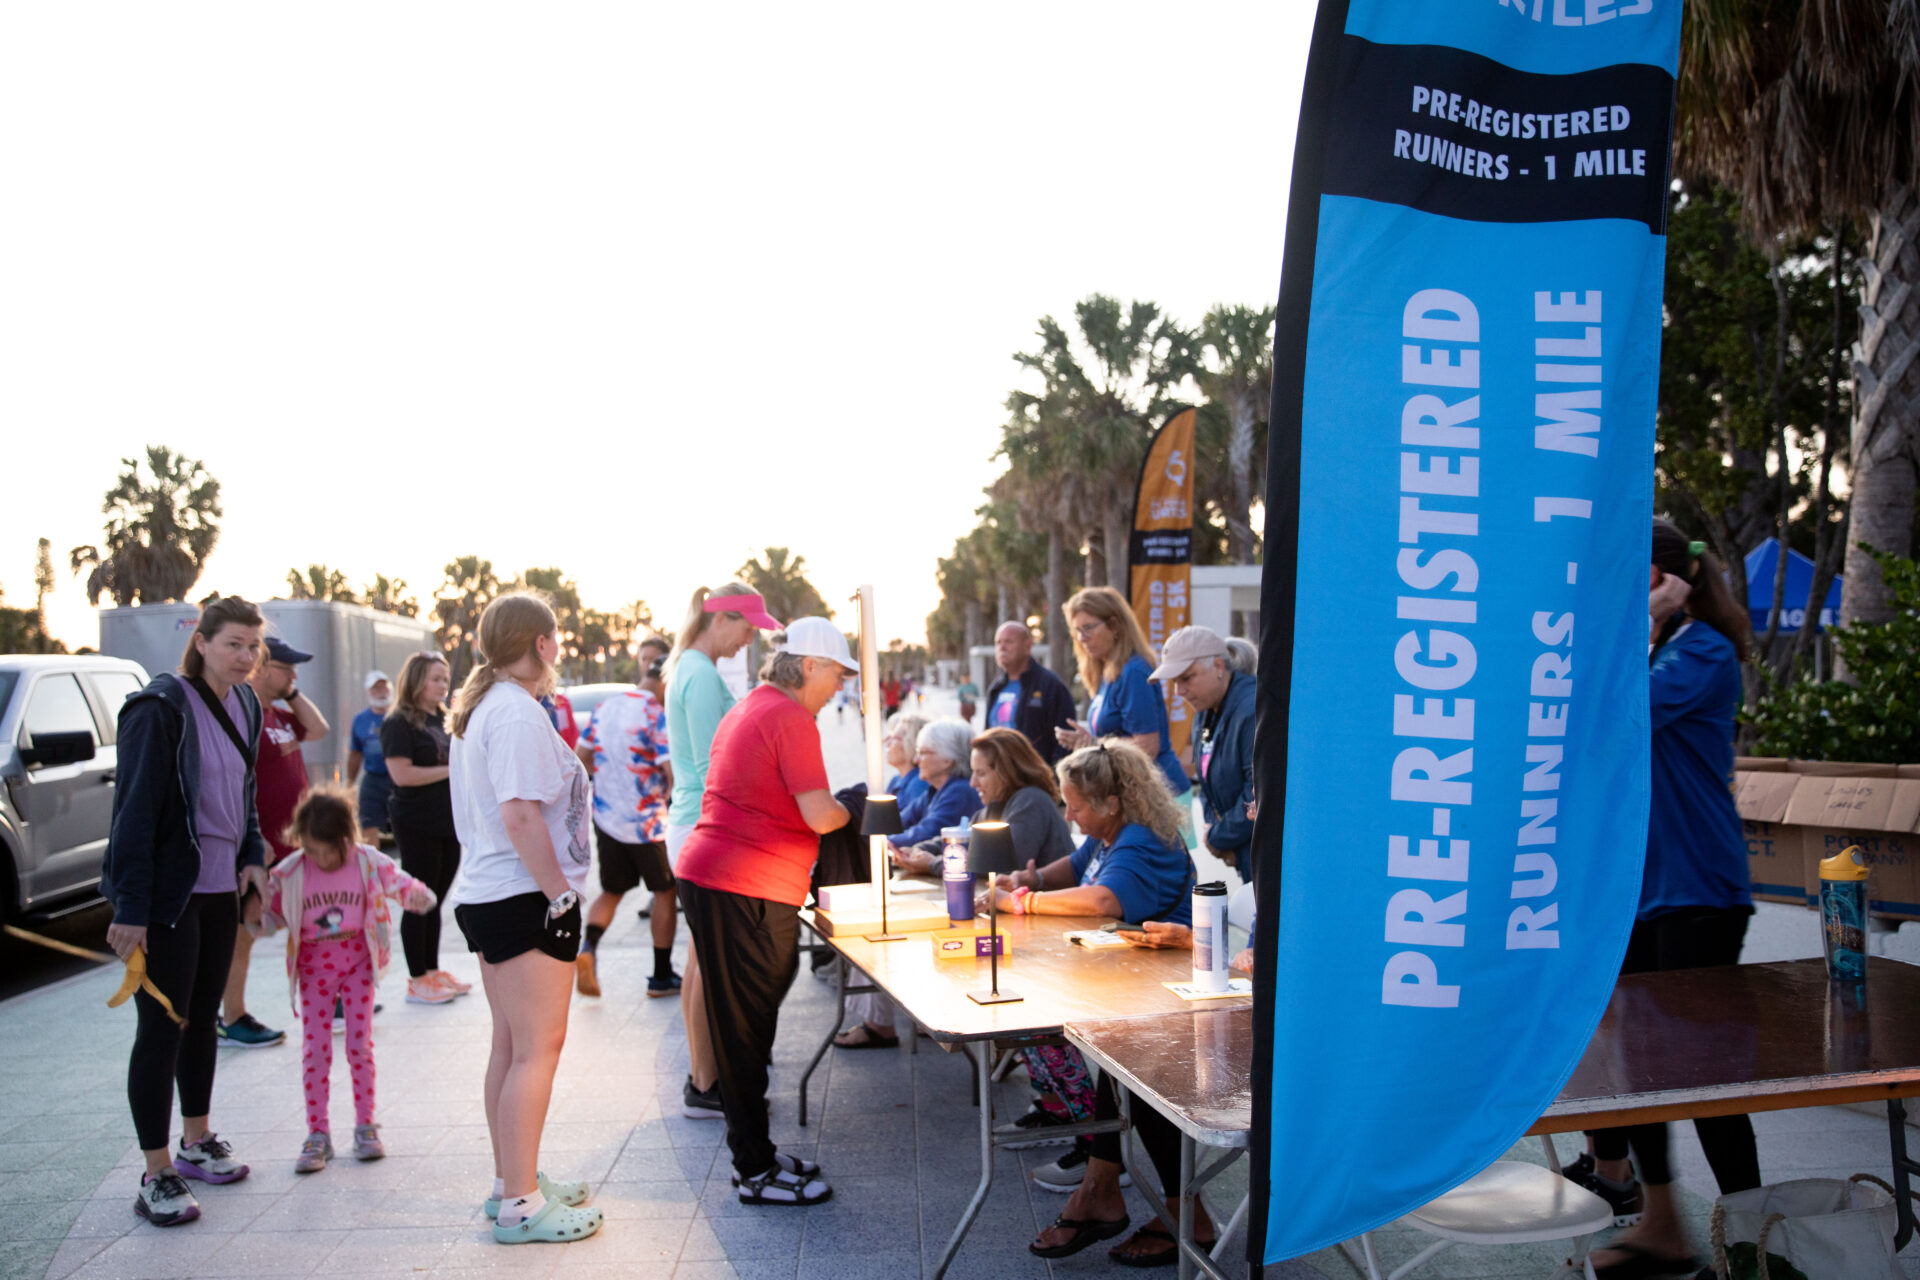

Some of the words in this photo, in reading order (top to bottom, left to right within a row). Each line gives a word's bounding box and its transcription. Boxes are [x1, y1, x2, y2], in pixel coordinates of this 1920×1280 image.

[1412, 85, 1631, 139] PRE-REGISTERED
[1393, 128, 1510, 180] RUNNERS
[1544, 155, 1556, 180] 1
[1573, 148, 1647, 178] MILE
[1534, 290, 1603, 459] MILE
[1534, 496, 1593, 523] 1
[1167, 580, 1187, 608] 5K
[1381, 288, 1480, 1008] PRE-REGISTERED
[1505, 611, 1575, 951] RUNNERS
[1824, 834, 1883, 852] PORT
[1825, 851, 1906, 866] CPANY
